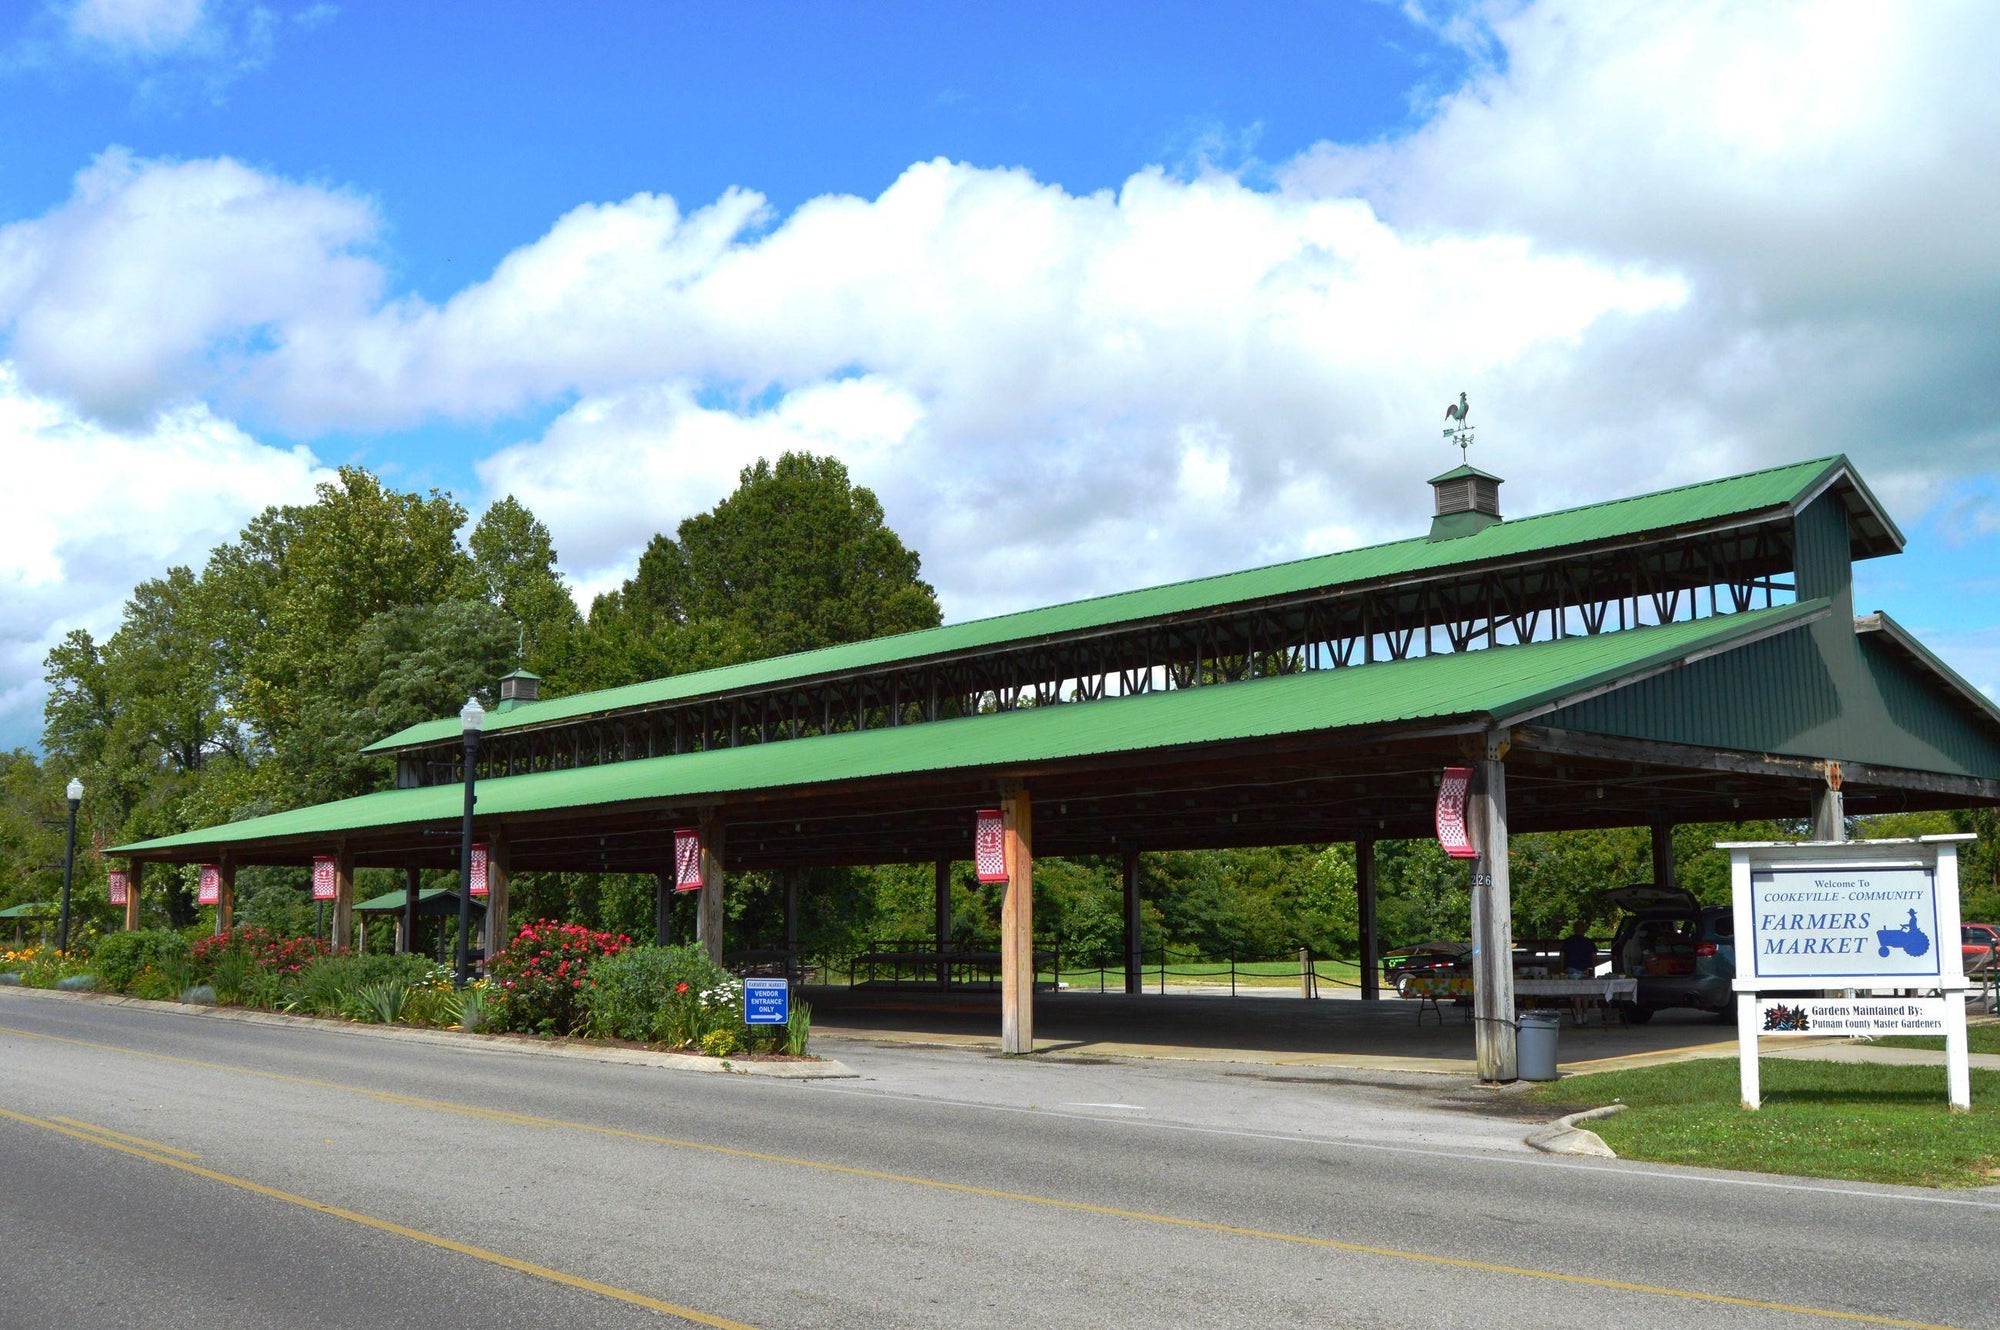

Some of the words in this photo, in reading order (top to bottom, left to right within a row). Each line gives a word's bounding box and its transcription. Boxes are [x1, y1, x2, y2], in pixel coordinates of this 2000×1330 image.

[1471, 874, 1491, 886] 226
[1814, 880, 1855, 888] Welcome
[1858, 879, 1870, 888] To
[1764, 892, 1840, 902] COOKEVILLE
[1848, 890, 1924, 901] COMMUNITY
[1761, 912, 1871, 931] FARMERS
[1763, 937, 1869, 955] MARKET
[1811, 1005, 1850, 1016] Gardens
[1852, 1005, 1905, 1016] Maintained
[1907, 1005, 1923, 1017] By:
[1812, 1019, 1843, 1028] Putnam
[1845, 1019, 1871, 1030] County
[1873, 1019, 1899, 1028] Master
[1901, 1019, 1942, 1028] Gardeners
